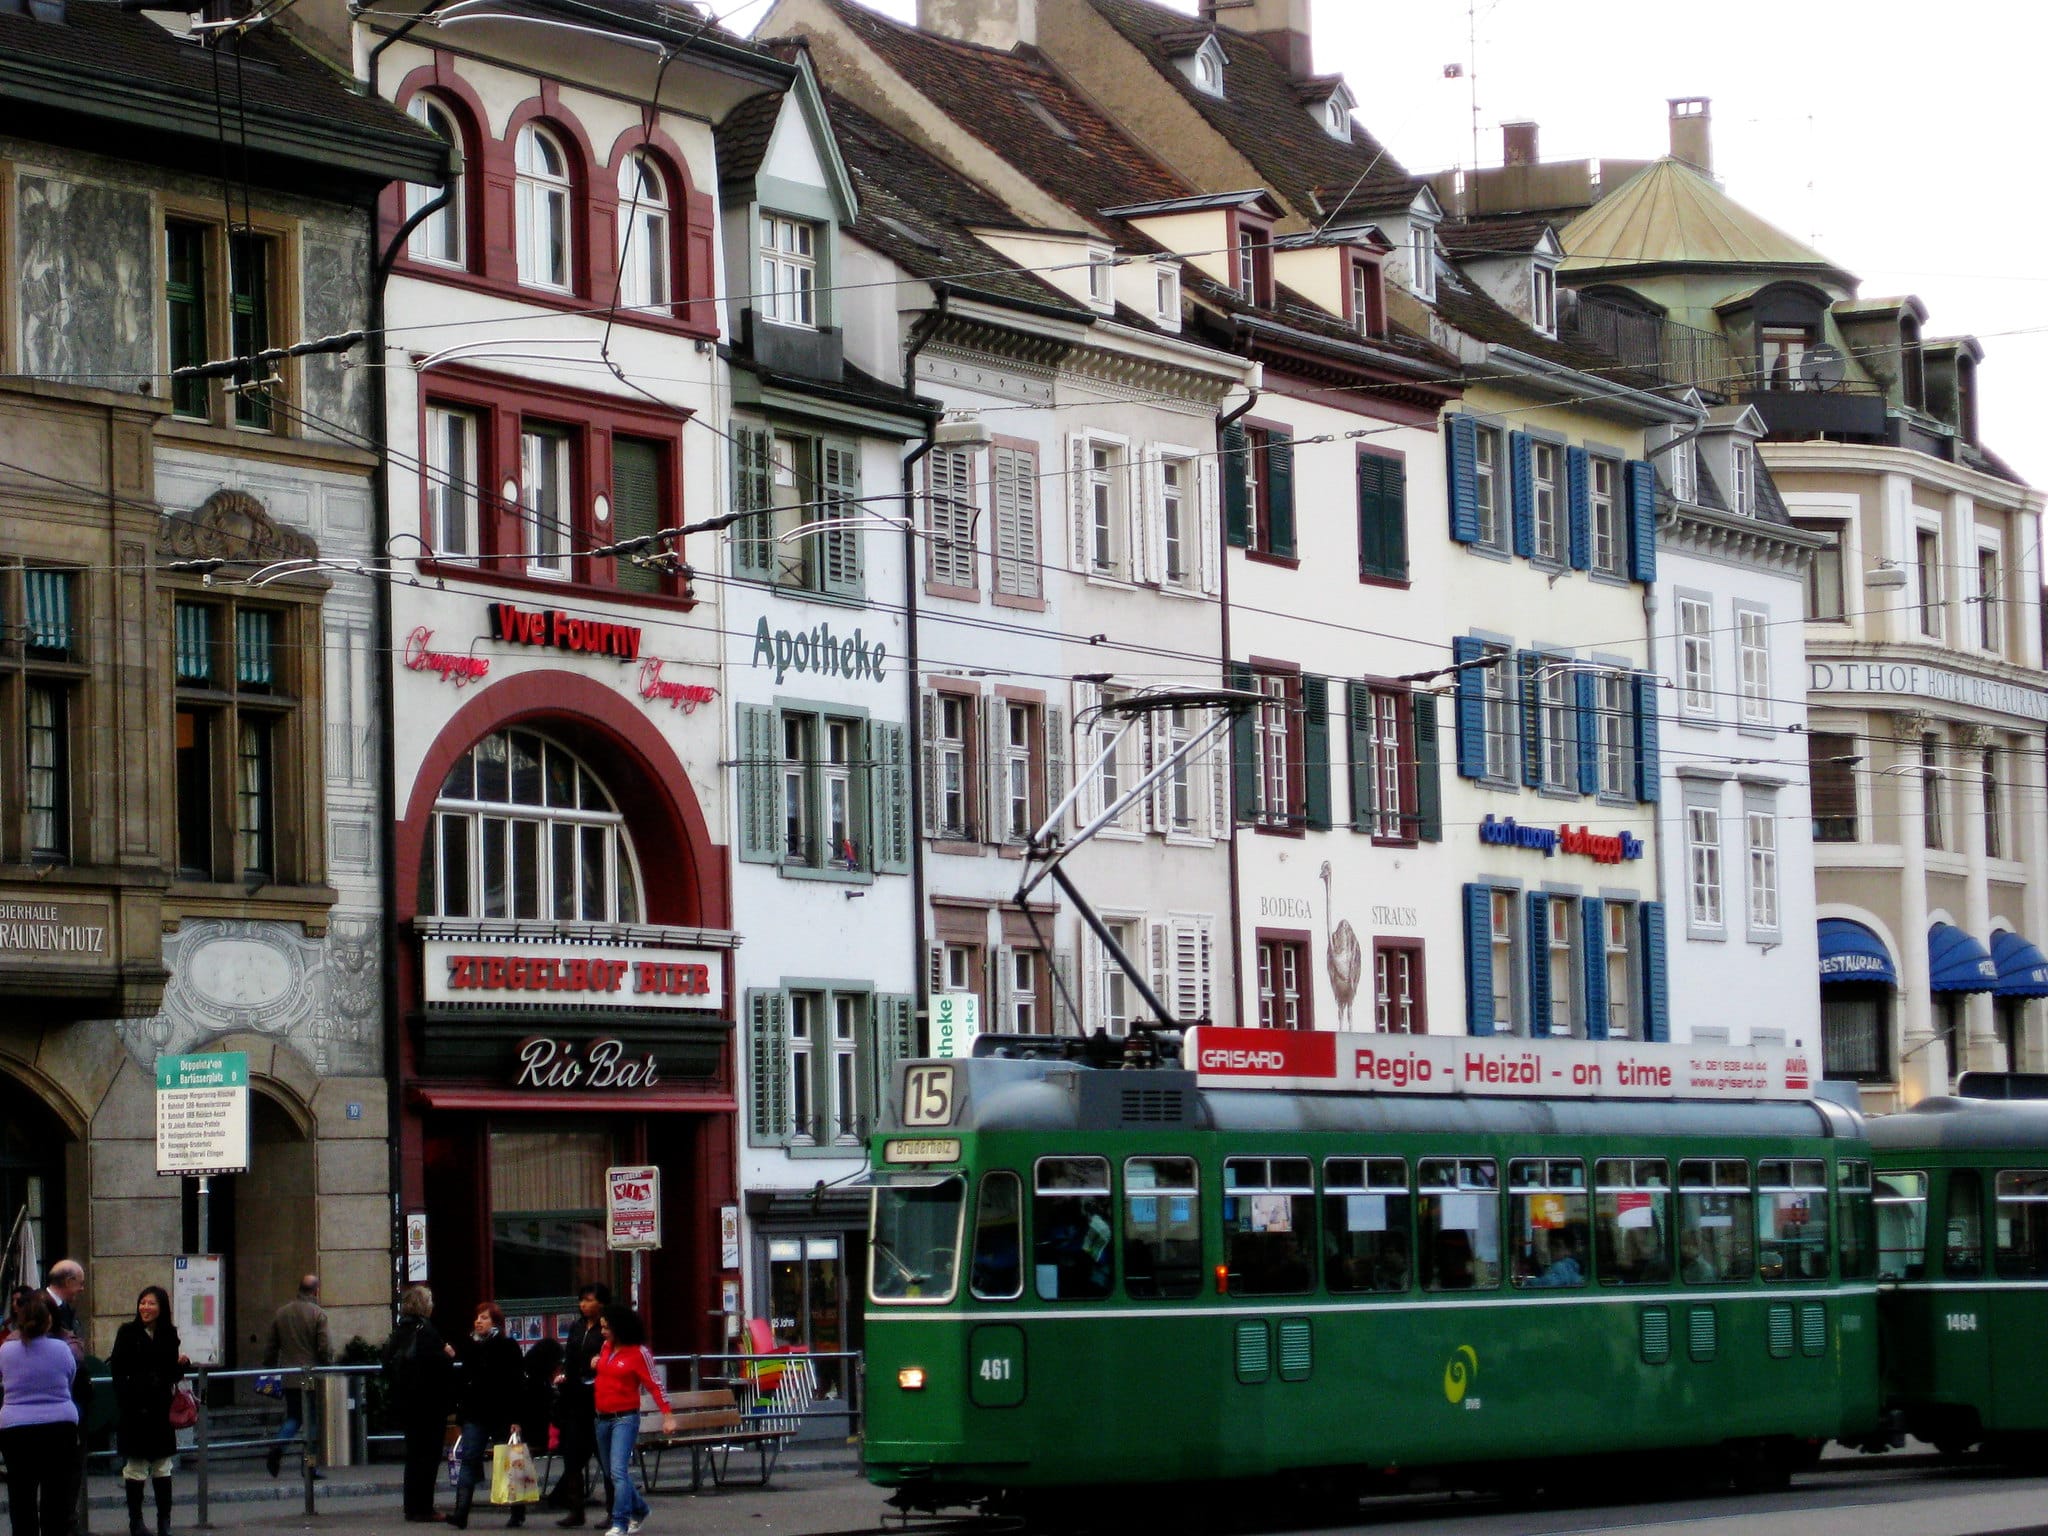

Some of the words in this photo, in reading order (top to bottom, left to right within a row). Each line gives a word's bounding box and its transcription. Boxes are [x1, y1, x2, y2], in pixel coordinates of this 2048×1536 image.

[489, 603, 545, 646] Vve
[546, 610, 641, 663] Fourny
[752, 615, 886, 685] Apotheke
[1928, 668, 1967, 702] HOTEL
[0, 905, 57, 920] BIERHALLE
[1260, 896, 1312, 919] BODEGA
[1372, 905, 1417, 926] STRAUSS
[62, 926, 103, 952] MUTZ
[447, 955, 628, 991] ZIEGELHOF
[634, 962, 710, 994] BIER
[517, 1038, 582, 1087] Rio
[586, 1040, 658, 1087] Bar
[1201, 1049, 1284, 1070] GRISARD
[1355, 1049, 1431, 1087] Regio
[1464, 1052, 1541, 1084] Heizöl
[1572, 1063, 1601, 1085] on
[1617, 1058, 1672, 1087] time
[912, 1072, 948, 1119] 15
[1946, 1314, 1976, 1330] 1464
[980, 1359, 1010, 1380] 461
